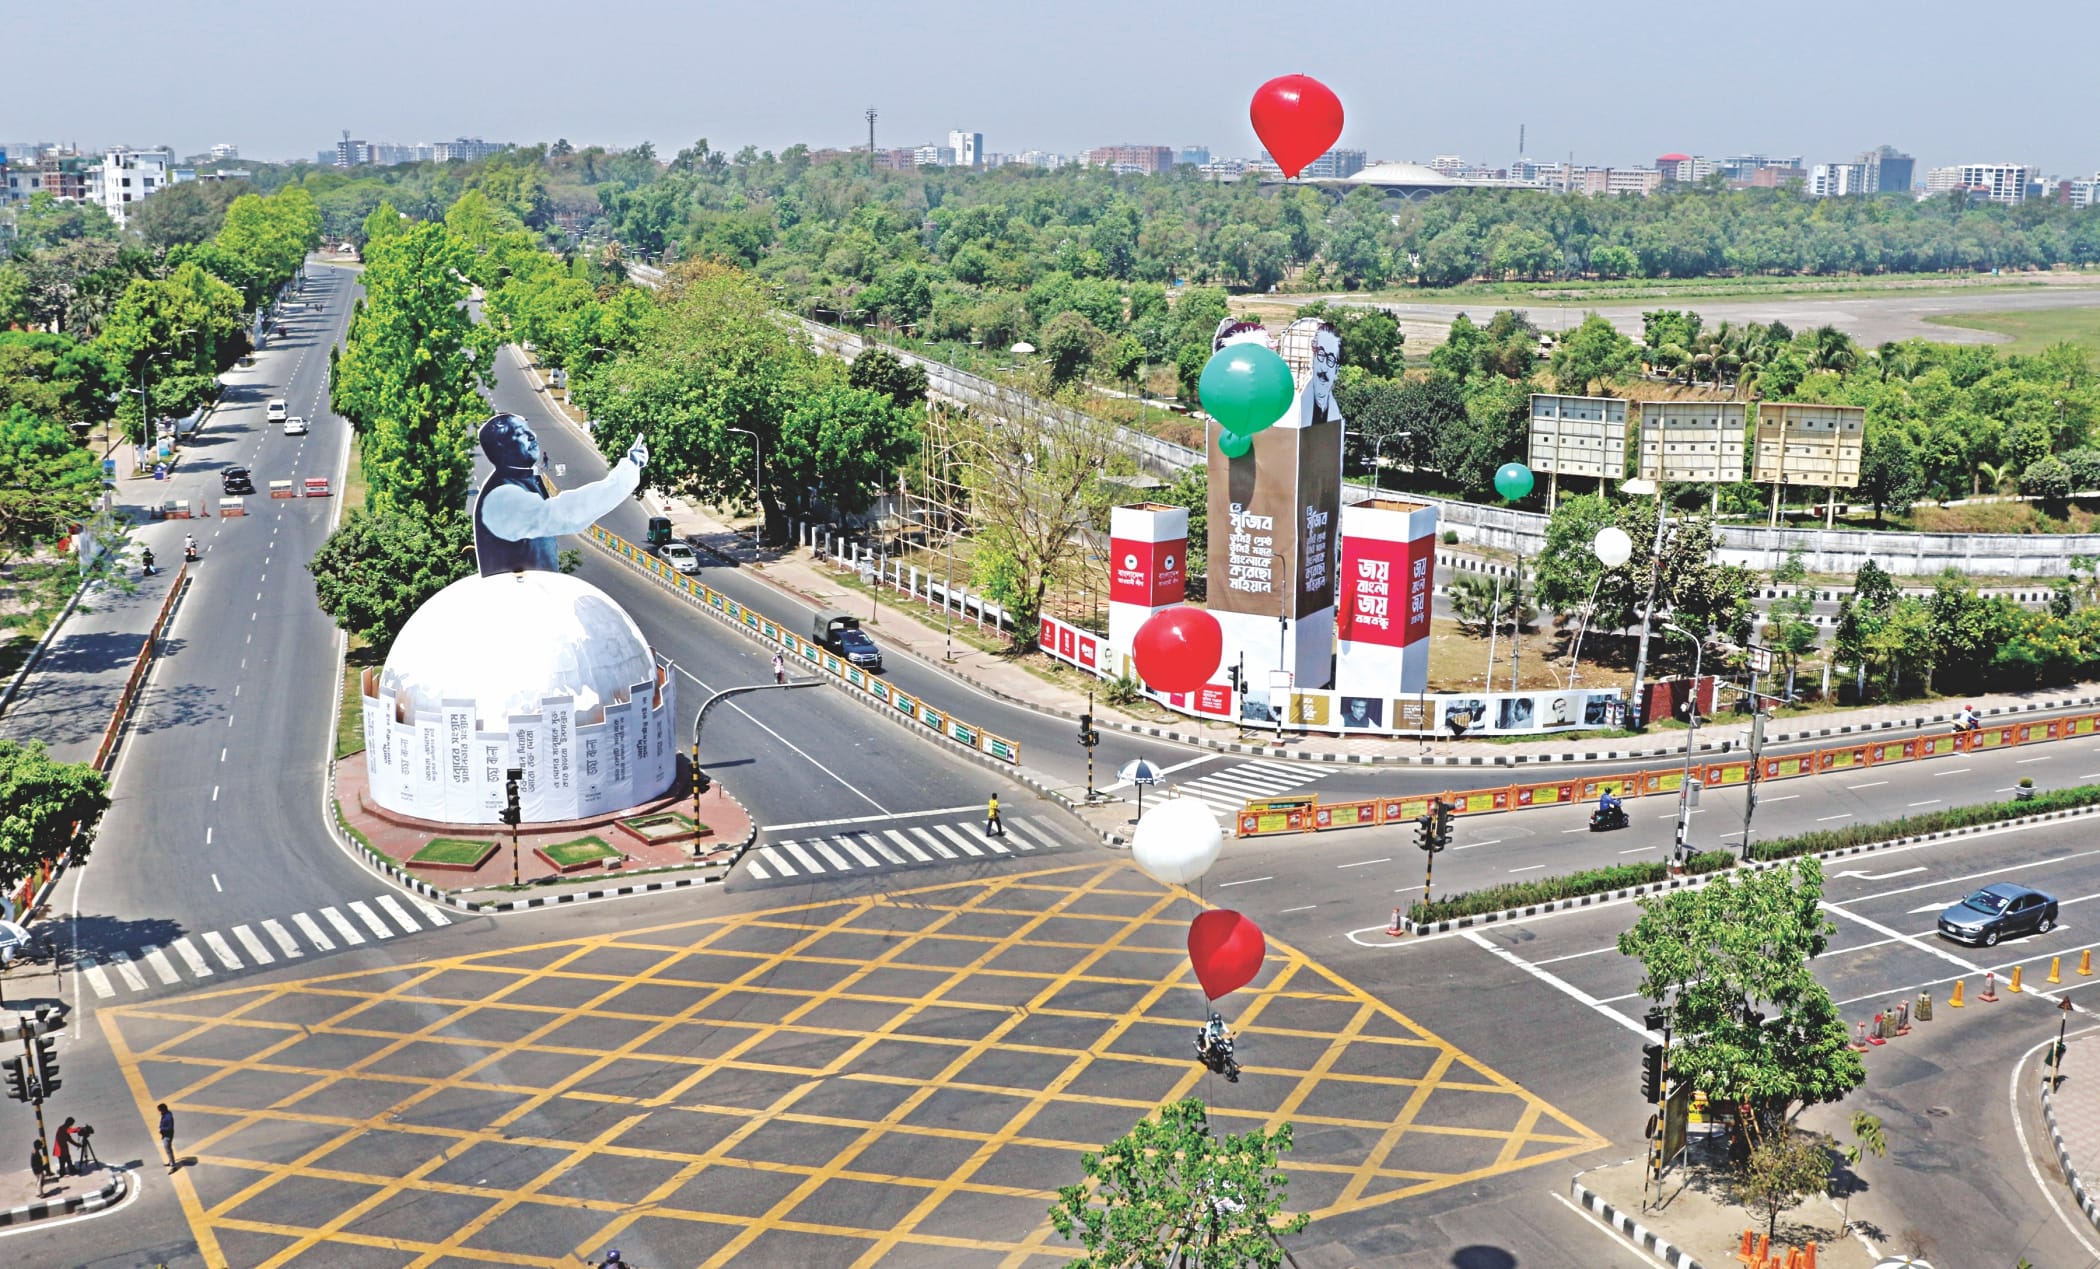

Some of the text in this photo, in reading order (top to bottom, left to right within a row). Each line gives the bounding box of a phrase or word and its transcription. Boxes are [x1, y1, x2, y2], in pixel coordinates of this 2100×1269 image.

[1229, 510, 1272, 533] মুজিব
[1229, 554, 1271, 567] বাংলাকে
[1357, 558, 1390, 583] জয়
[1229, 564, 1272, 581] করেছো
[1228, 577, 1272, 593] মহিয়ান
[1356, 580, 1389, 595] বাংলা
[1357, 594, 1388, 617] জয়
[460, 714, 469, 740] সংগ্রাম
[450, 714, 461, 783] এবারের সংগ্রাম
[487, 767, 500, 782] জয়
